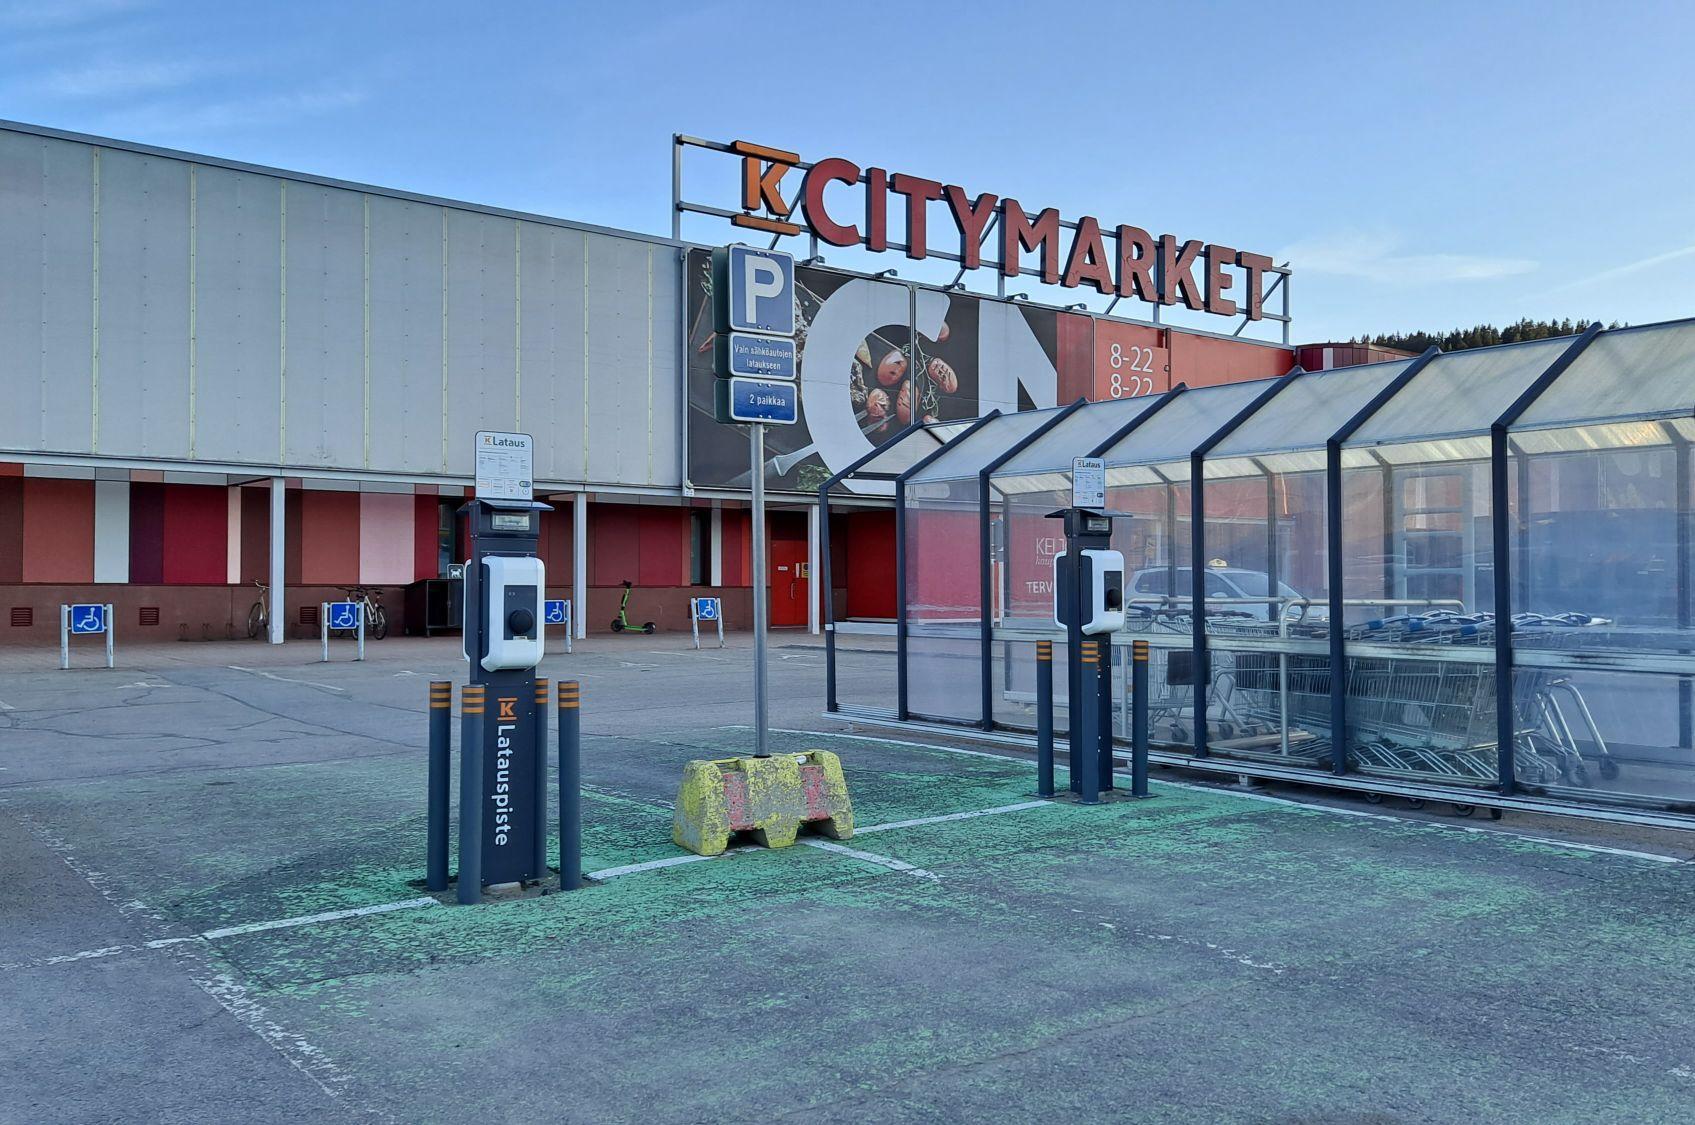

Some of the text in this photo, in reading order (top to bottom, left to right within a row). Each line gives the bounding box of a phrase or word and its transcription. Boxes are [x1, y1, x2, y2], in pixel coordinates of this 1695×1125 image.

[801, 157, 1273, 321] CITYMARKET
[744, 254, 784, 324] P
[734, 344, 793, 360] Vain sähköautojen
[1110, 343, 1153, 373] 8-22
[746, 359, 781, 370] lataukseen
[1110, 373, 1153, 398] 8-22
[749, 393, 786, 407] 2 paikkaa
[493, 436, 526, 448] Lataus
[1083, 460, 1101, 469] Lataus
[1025, 581, 1054, 594] TERV
[497, 697, 518, 720] K
[491, 724, 516, 846] Latauspiste
